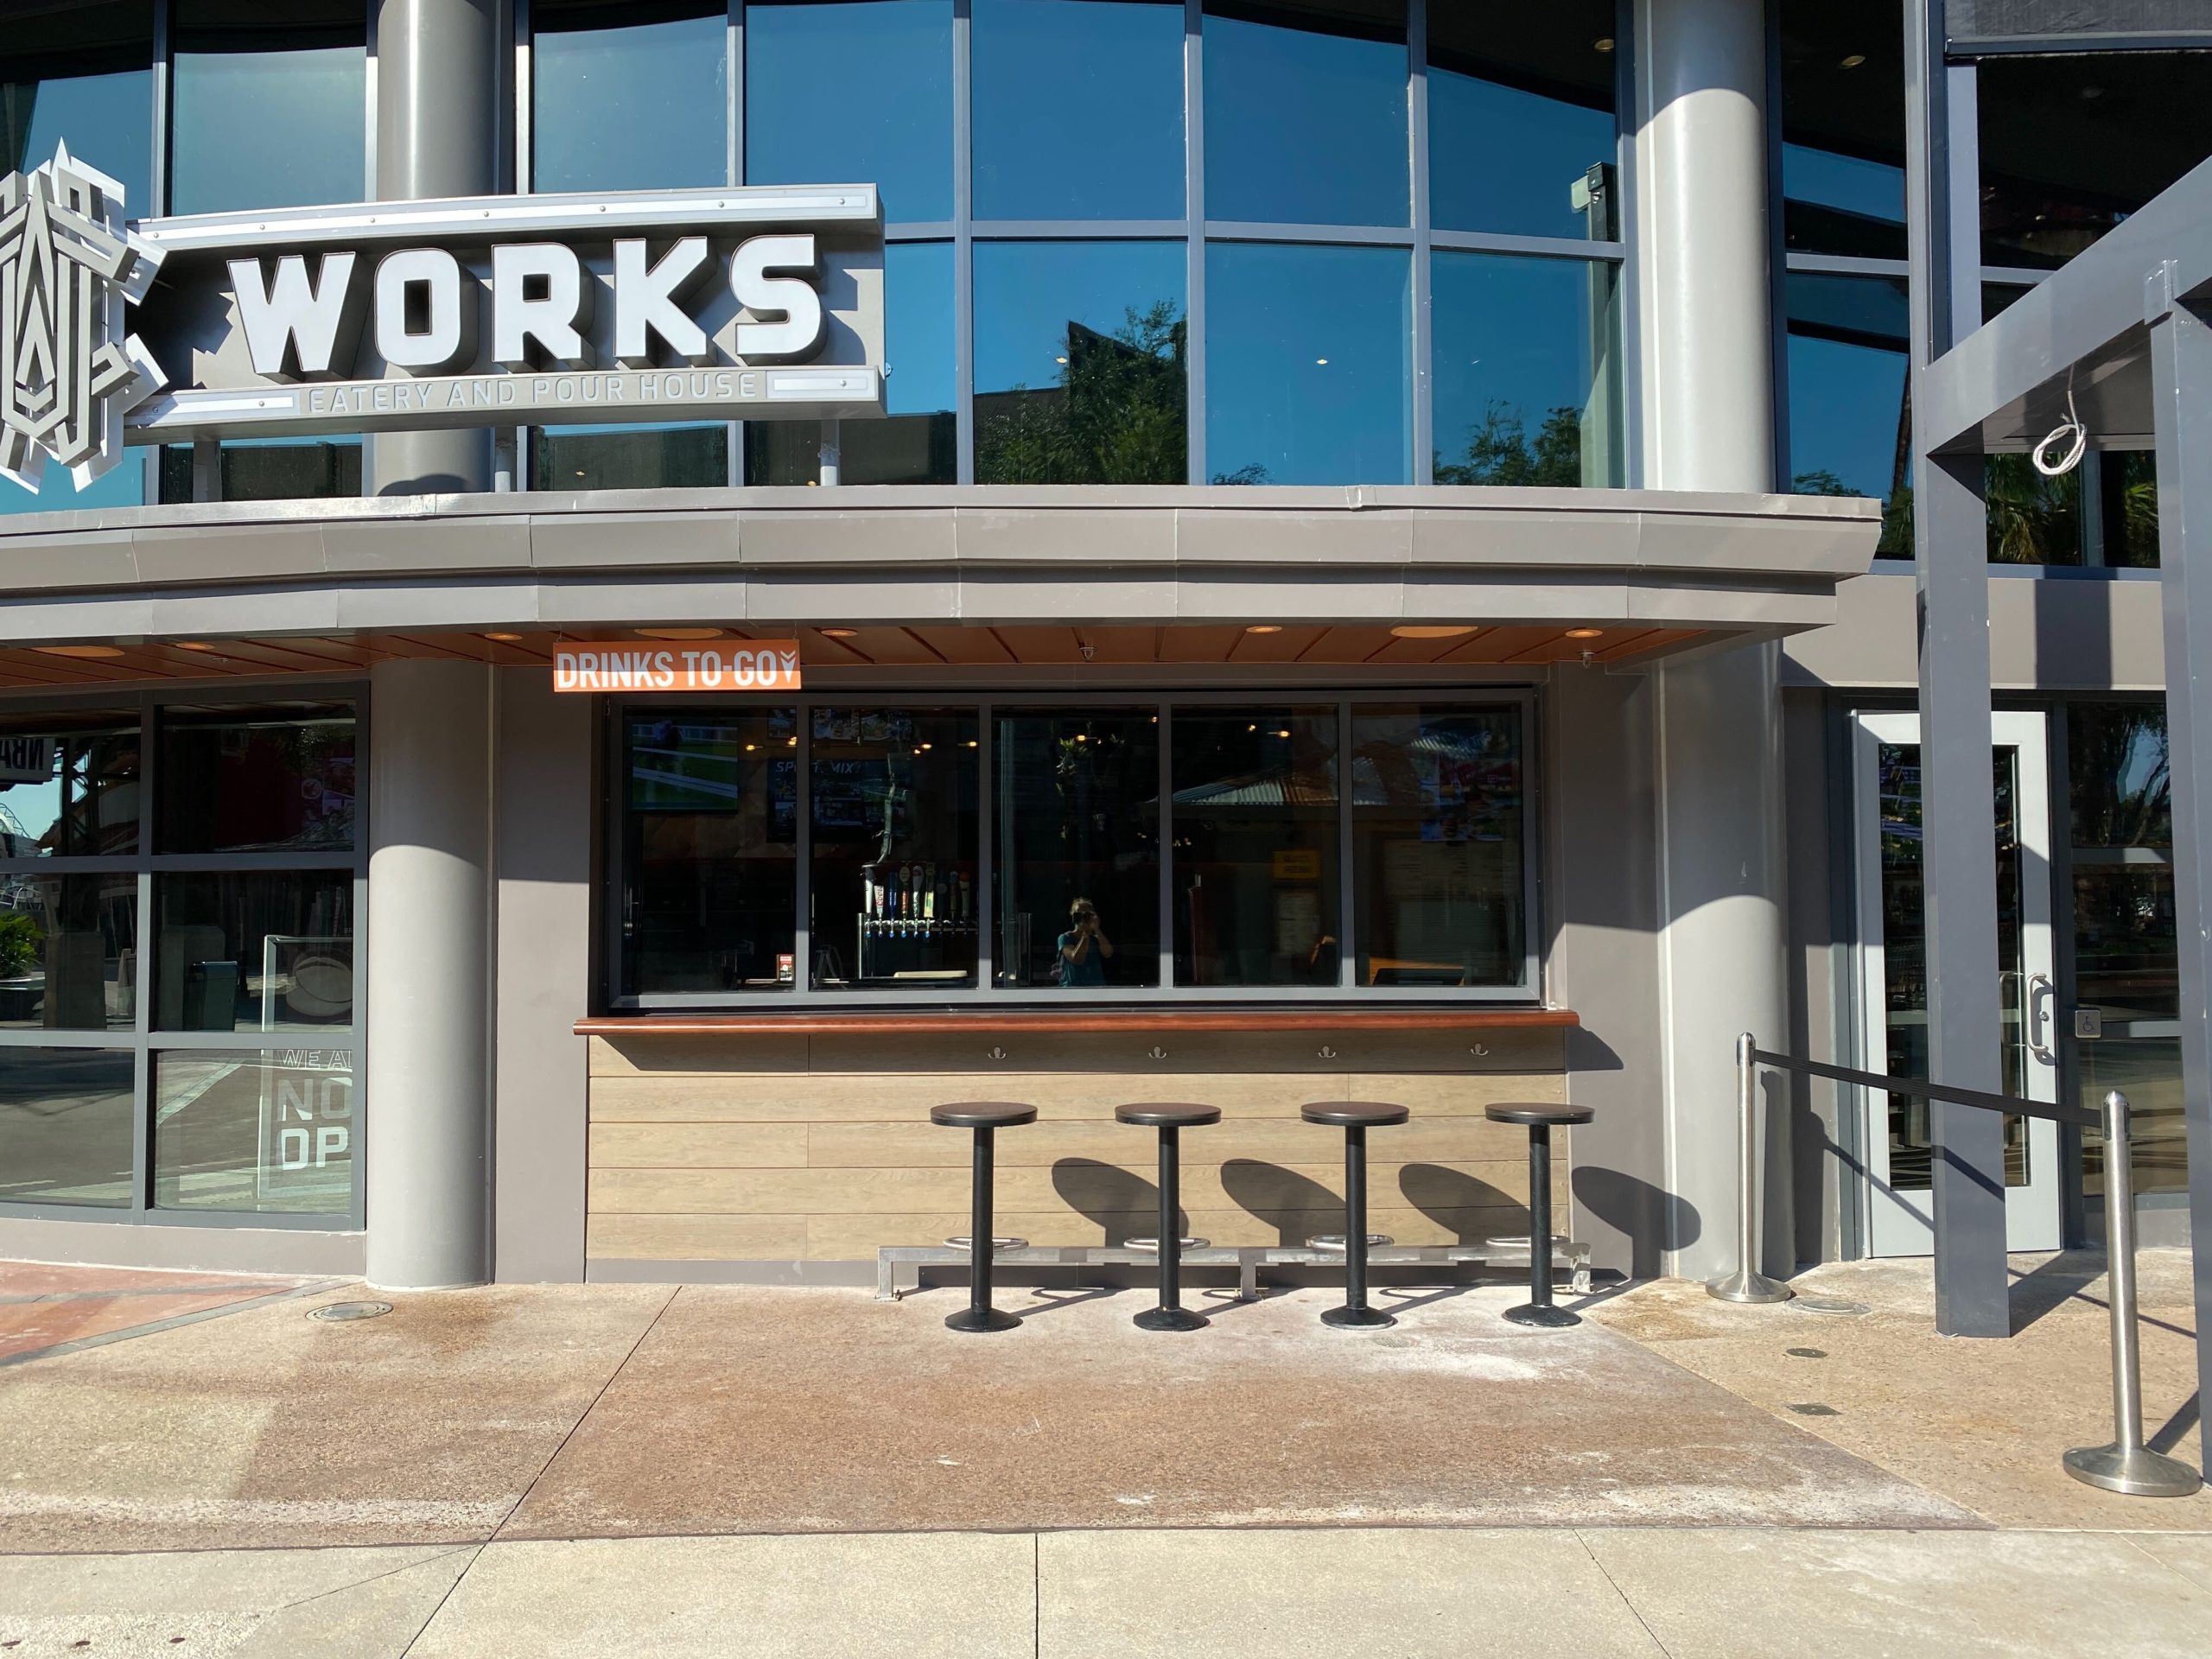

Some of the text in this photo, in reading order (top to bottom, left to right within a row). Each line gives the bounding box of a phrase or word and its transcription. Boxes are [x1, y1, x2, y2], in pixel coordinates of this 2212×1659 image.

[227, 233, 824, 376] WORKS
[308, 372, 755, 413] EATERY AND POUR HOUSE
[556, 650, 777, 688] DRINKS TO-GO
[283, 1049, 321, 1069] WE
